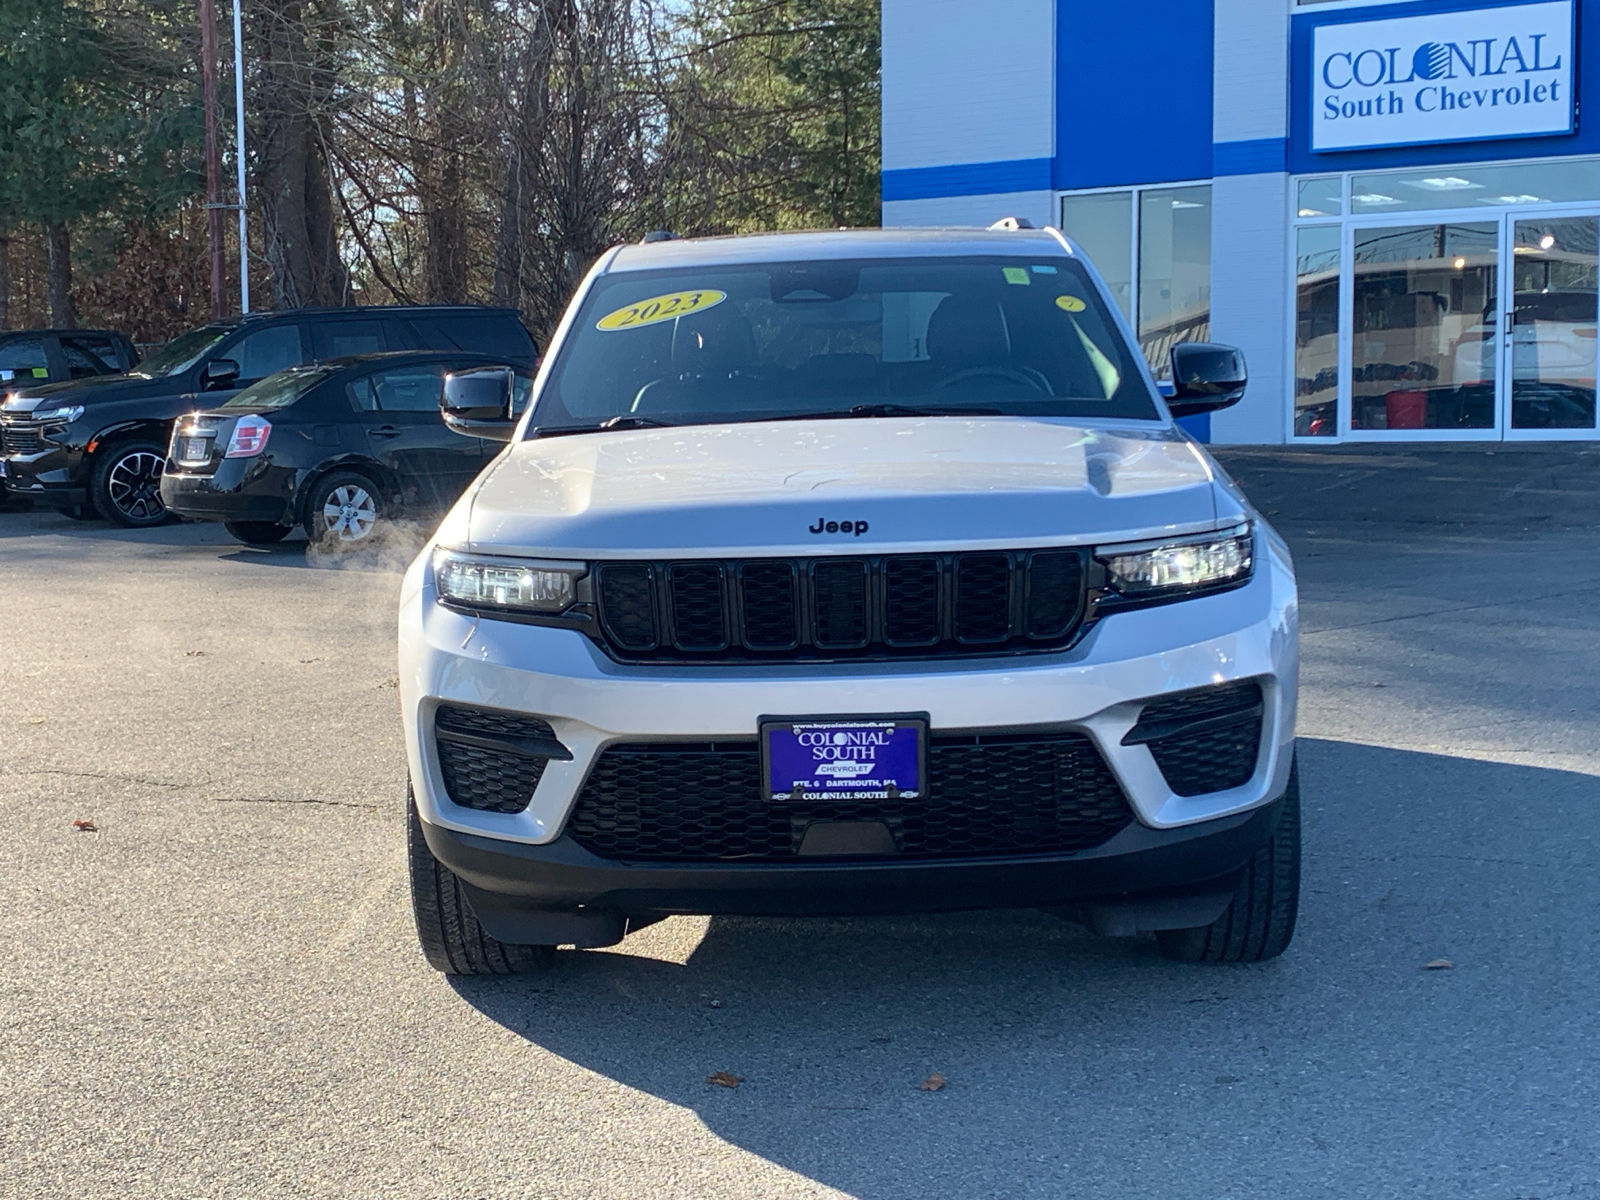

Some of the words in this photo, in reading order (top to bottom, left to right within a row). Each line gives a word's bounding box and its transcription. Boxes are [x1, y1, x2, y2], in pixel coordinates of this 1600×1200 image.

[1322, 33, 1562, 90] COLONIAL
[1323, 90, 1404, 120] South
[1415, 78, 1561, 112] Chevrolet
[618, 293, 702, 327] 2023
[809, 517, 869, 537] Jeep
[792, 722, 895, 730] www.buycolonialsouth.com
[798, 731, 890, 746] COLONIAL
[812, 746, 875, 760] SOUTH
[820, 765, 868, 773] CHEVROLET
[826, 780, 882, 788] DARTMOUTH,
[802, 791, 853, 800] COLONIAL
[853, 791, 889, 799] SOUTH
